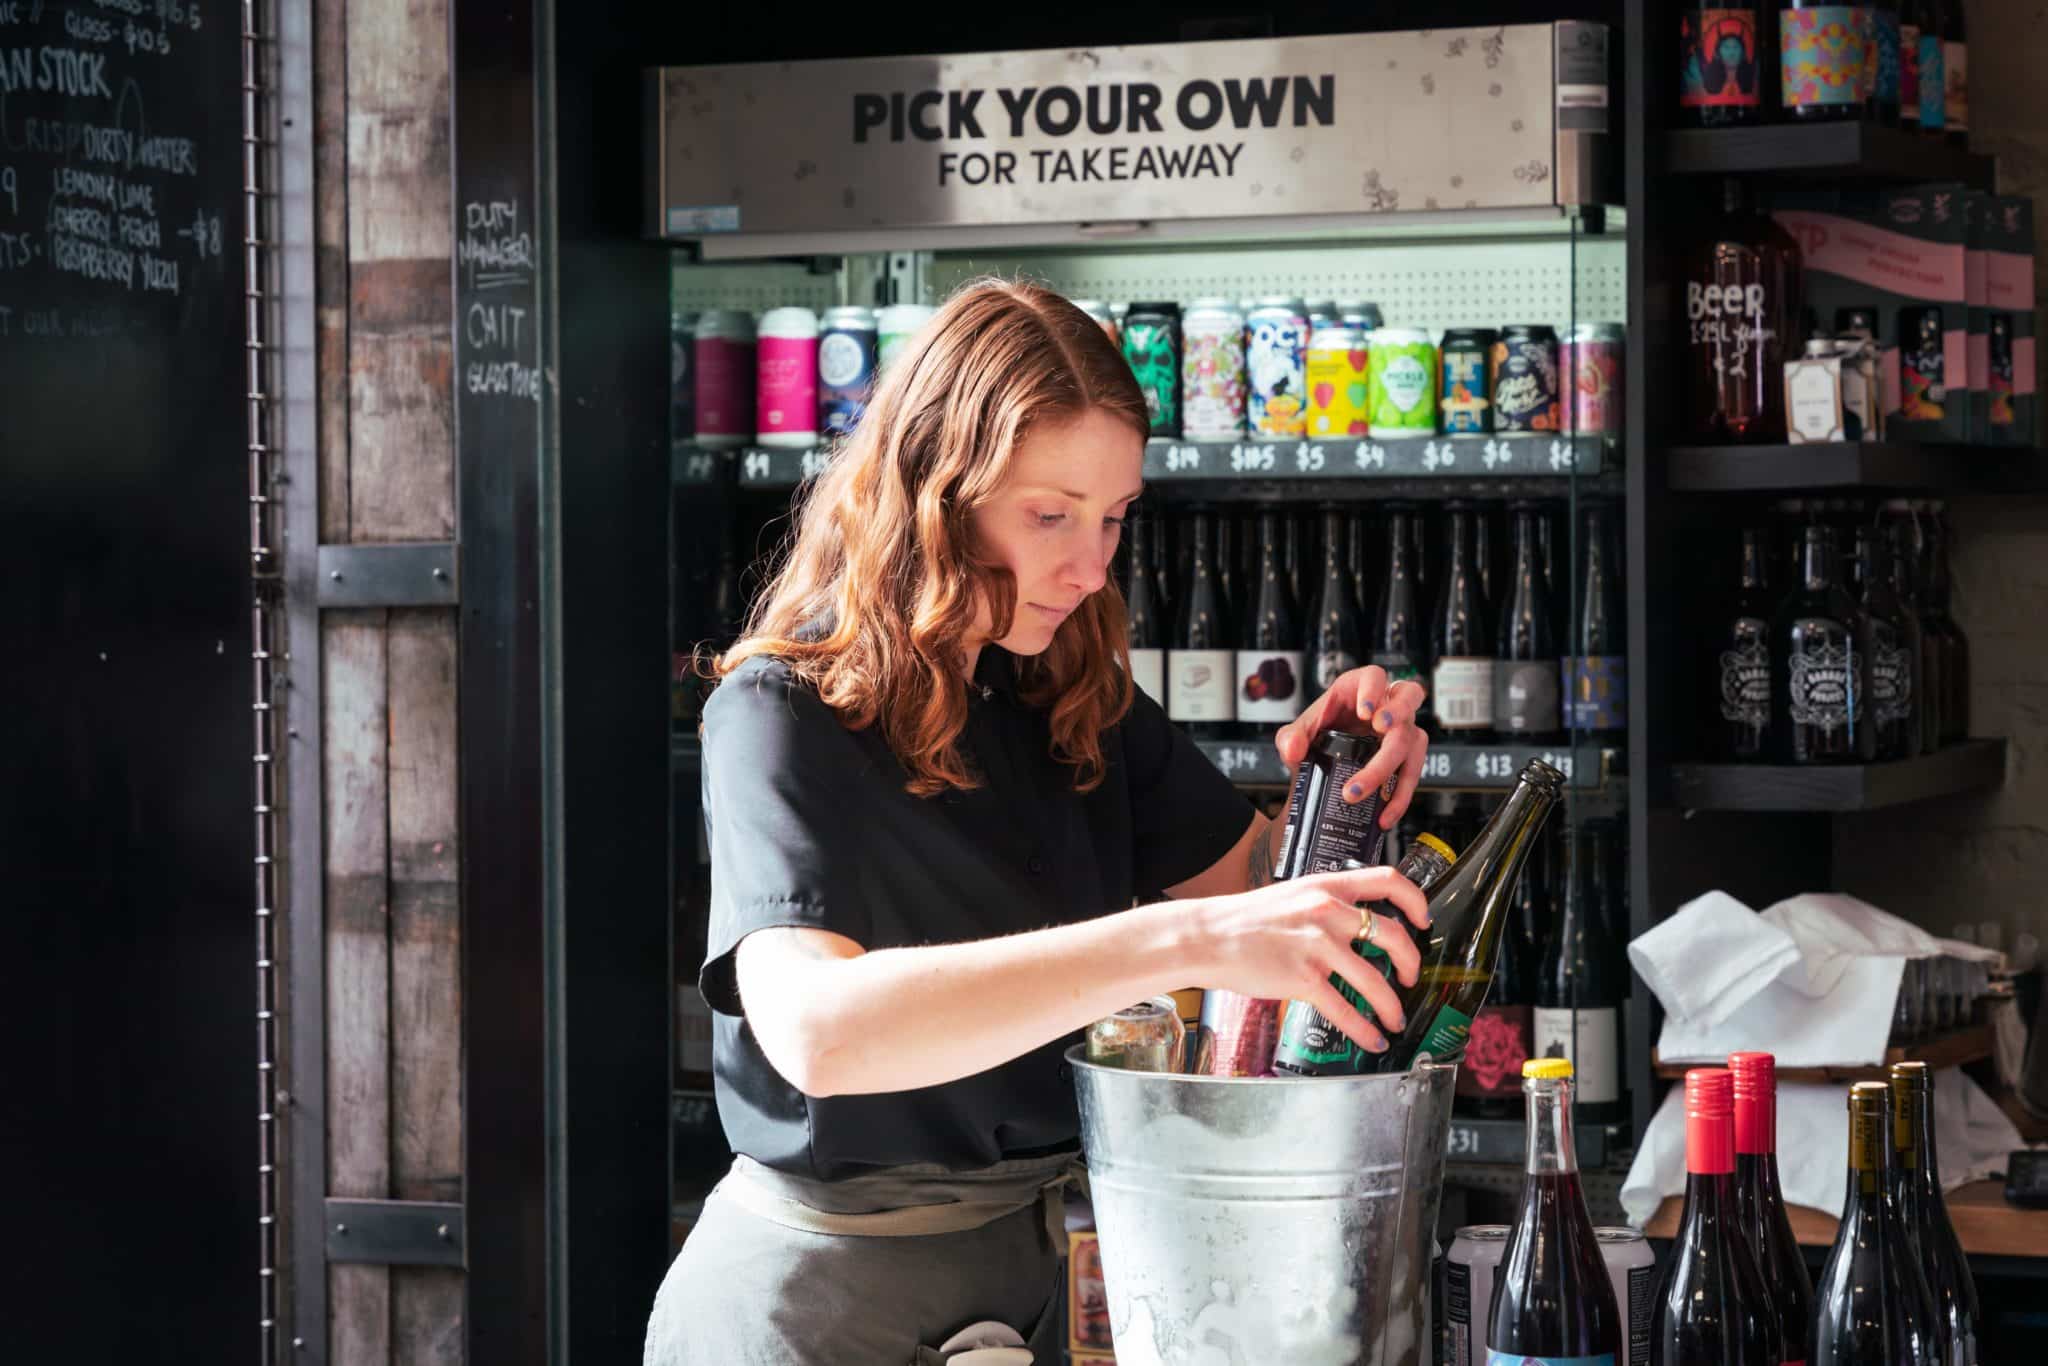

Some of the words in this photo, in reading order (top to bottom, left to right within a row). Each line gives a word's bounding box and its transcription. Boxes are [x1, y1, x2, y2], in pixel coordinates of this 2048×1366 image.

[37, 45, 113, 98] STOCK
[853, 90, 986, 143] PICK
[997, 82, 1164, 136] YOUR
[1176, 74, 1334, 131] OWN
[82, 126, 133, 171] DIRTY
[140, 136, 197, 176] WATER
[938, 151, 1017, 188] FOR
[1030, 142, 1244, 183] TAKEAWAY
[466, 198, 518, 238] DUTY
[1296, 441, 1325, 472] $5
[1422, 440, 1456, 472] $6
[1483, 439, 1513, 470] $6
[1218, 747, 1259, 778] $14
[1475, 751, 1513, 779] $13
